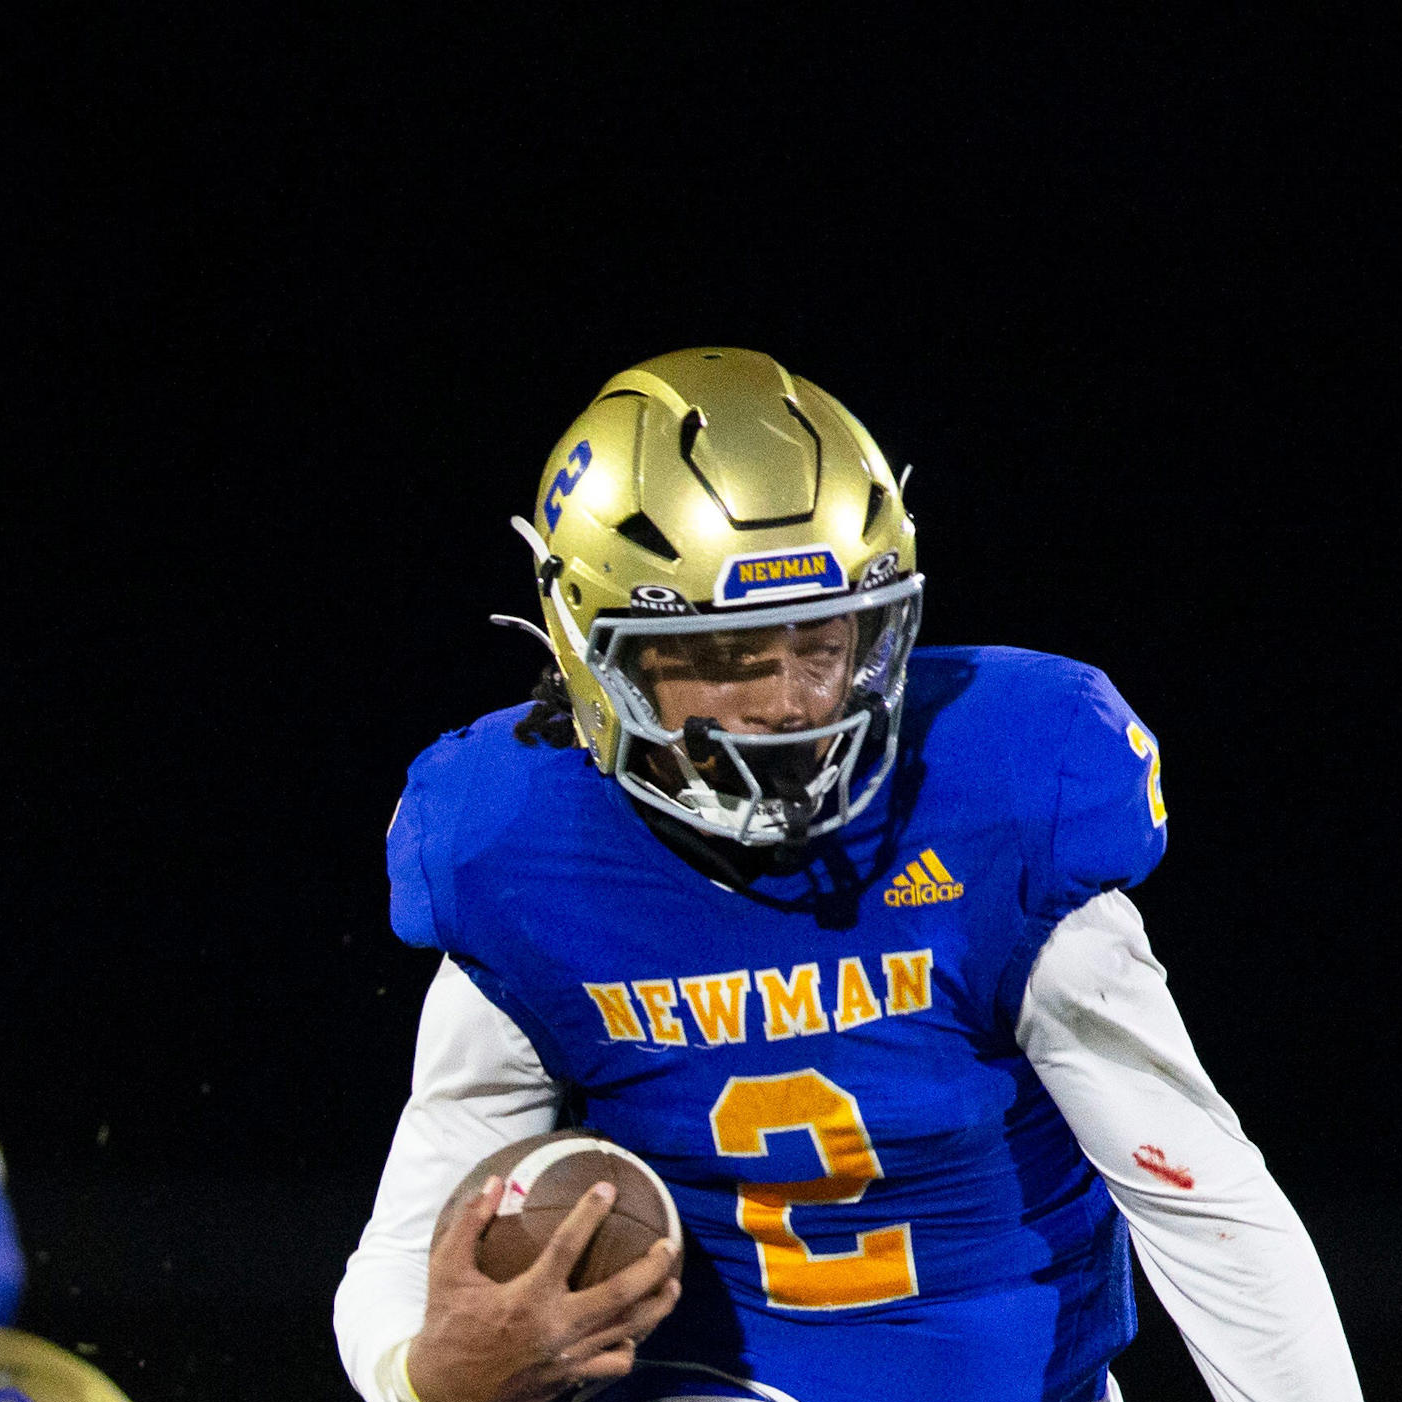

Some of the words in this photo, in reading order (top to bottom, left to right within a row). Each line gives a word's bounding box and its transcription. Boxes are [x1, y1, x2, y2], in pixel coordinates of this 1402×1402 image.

[543, 438, 593, 535] 2
[738, 554, 828, 584] NEWMAN
[883, 881, 965, 908] adidas
[581, 948, 935, 1048] NEWMAN
[709, 1067, 920, 1312] 2
